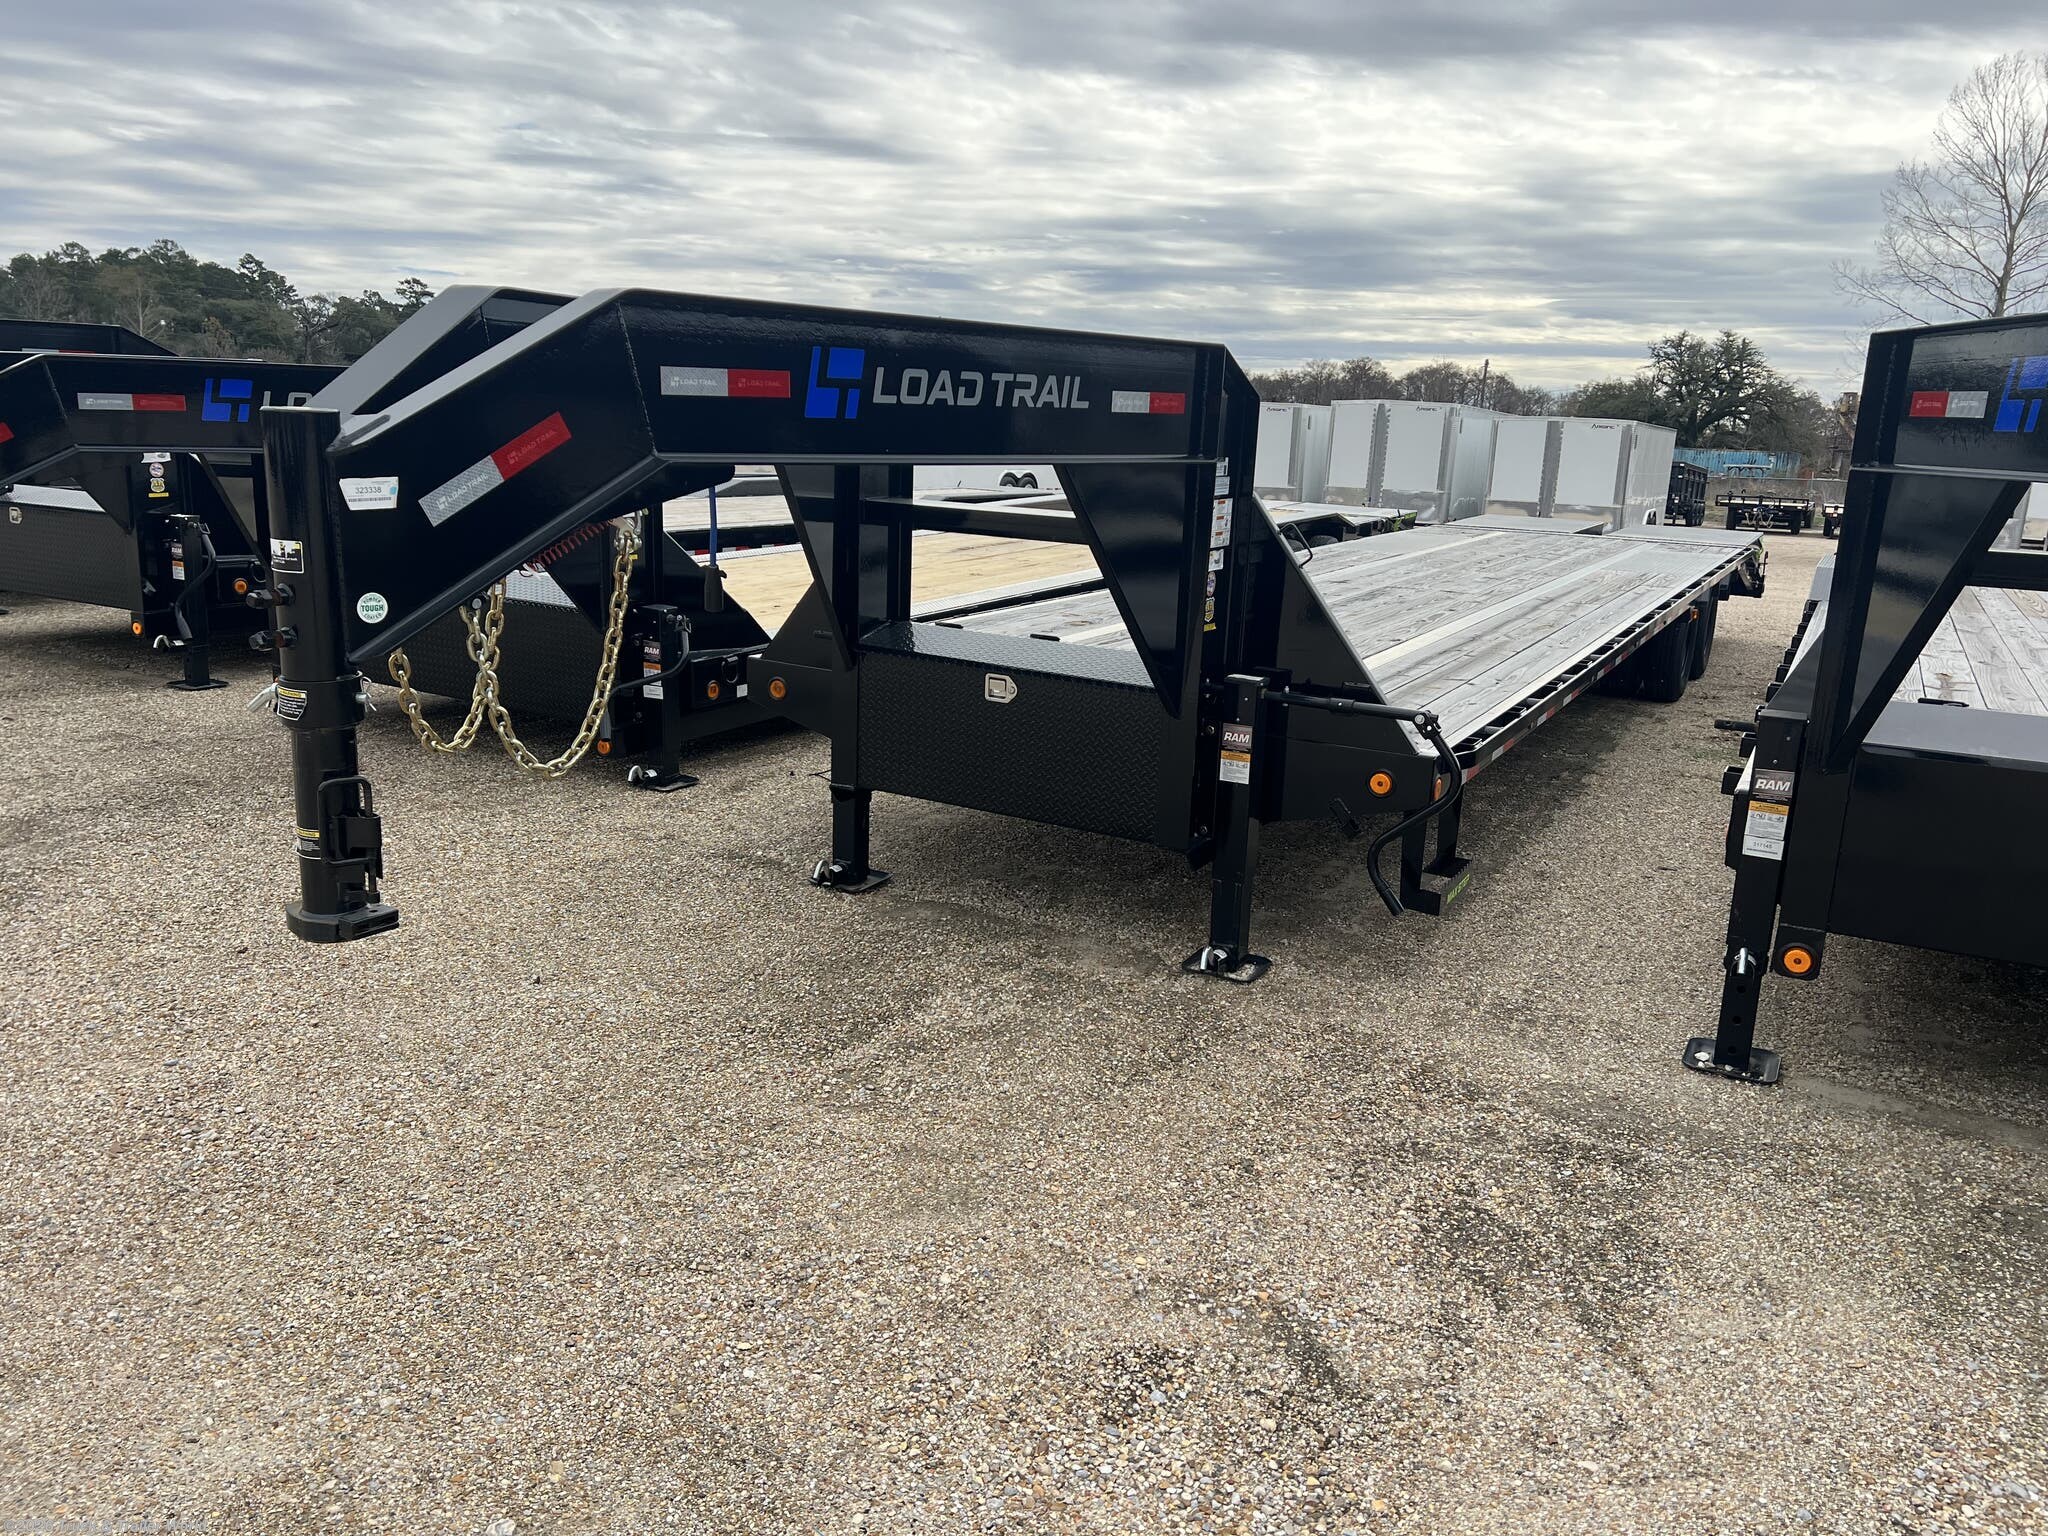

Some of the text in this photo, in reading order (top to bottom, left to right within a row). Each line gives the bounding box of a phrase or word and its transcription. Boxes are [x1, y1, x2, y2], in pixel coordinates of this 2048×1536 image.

[873, 367, 1090, 409] LOAD TRAIL
[355, 486, 382, 494] 323338
[361, 604, 384, 612] TOUGH
[644, 646, 660, 655] RAM
[1224, 731, 1250, 744] RAM
[1755, 779, 1791, 791] RAM
